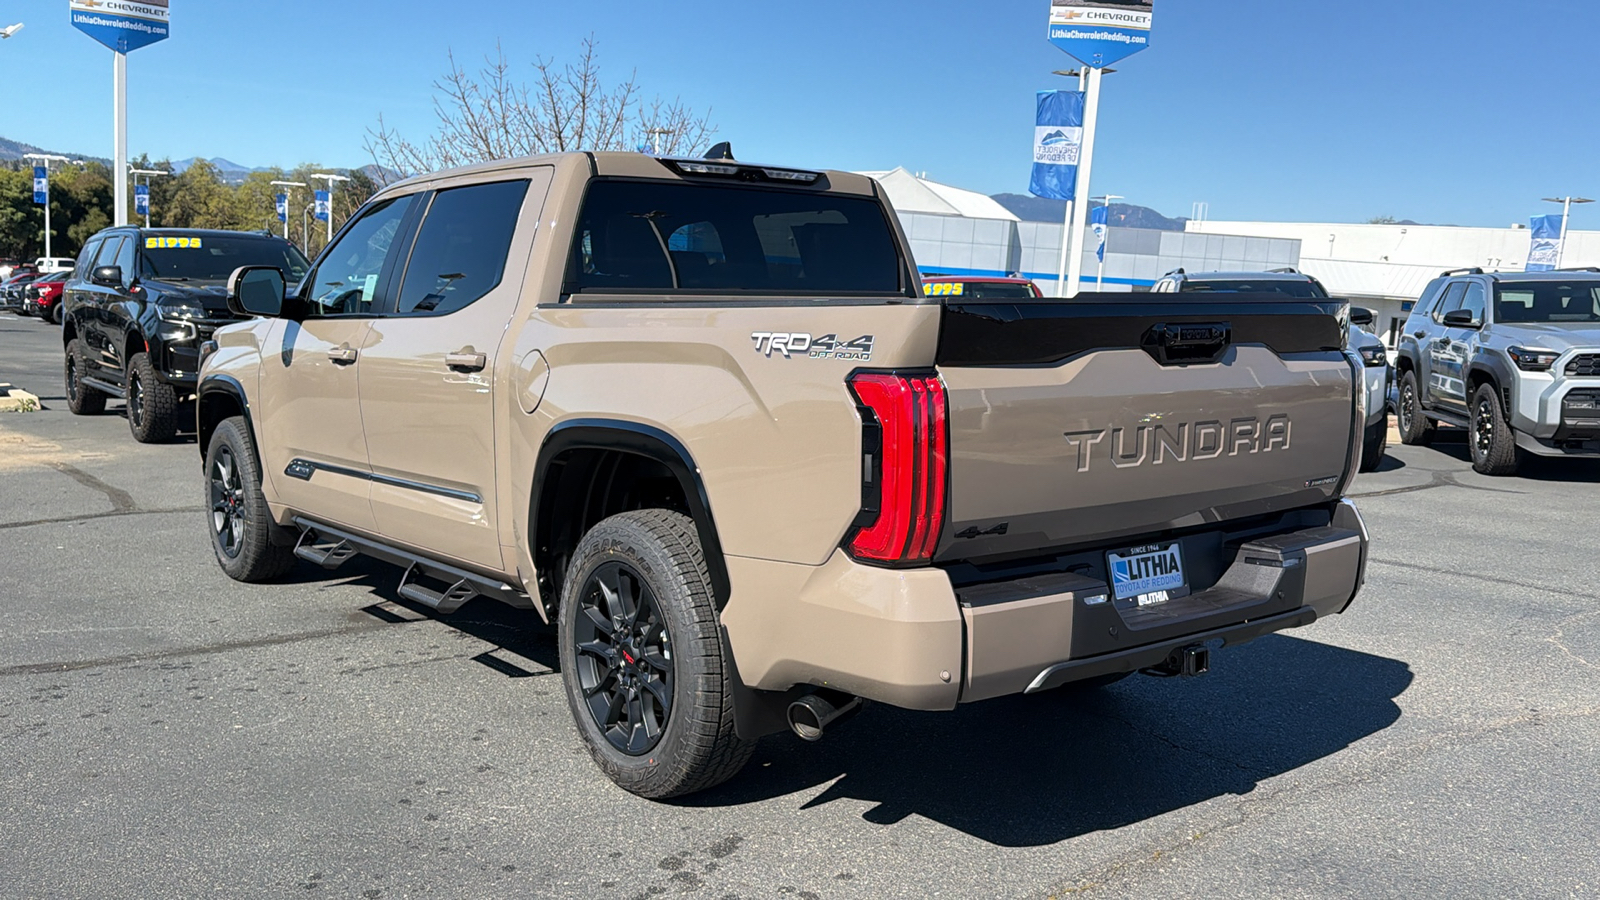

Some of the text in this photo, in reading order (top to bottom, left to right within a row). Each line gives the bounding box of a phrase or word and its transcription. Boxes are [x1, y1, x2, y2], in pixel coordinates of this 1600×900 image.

[107, 2, 166, 16] CHEVROLET
[73, 14, 167, 34] LithiaChevroletRedding.com
[1087, 12, 1148, 23] CHEVROLET
[1051, 29, 1146, 44] LithiaChevroletRedding.com
[145, 236, 202, 249] 51995
[1181, 329, 1211, 339] TOYOTA
[751, 331, 812, 359] TRD
[808, 351, 872, 362] OFF ROAD
[1063, 413, 1292, 473] TUNDRA
[1130, 544, 1159, 554] SINCE 1946
[1128, 552, 1180, 580] LITHIA
[1115, 574, 1181, 594] TOYOTA OF REDDING
[1144, 590, 1169, 604] LITHIA
